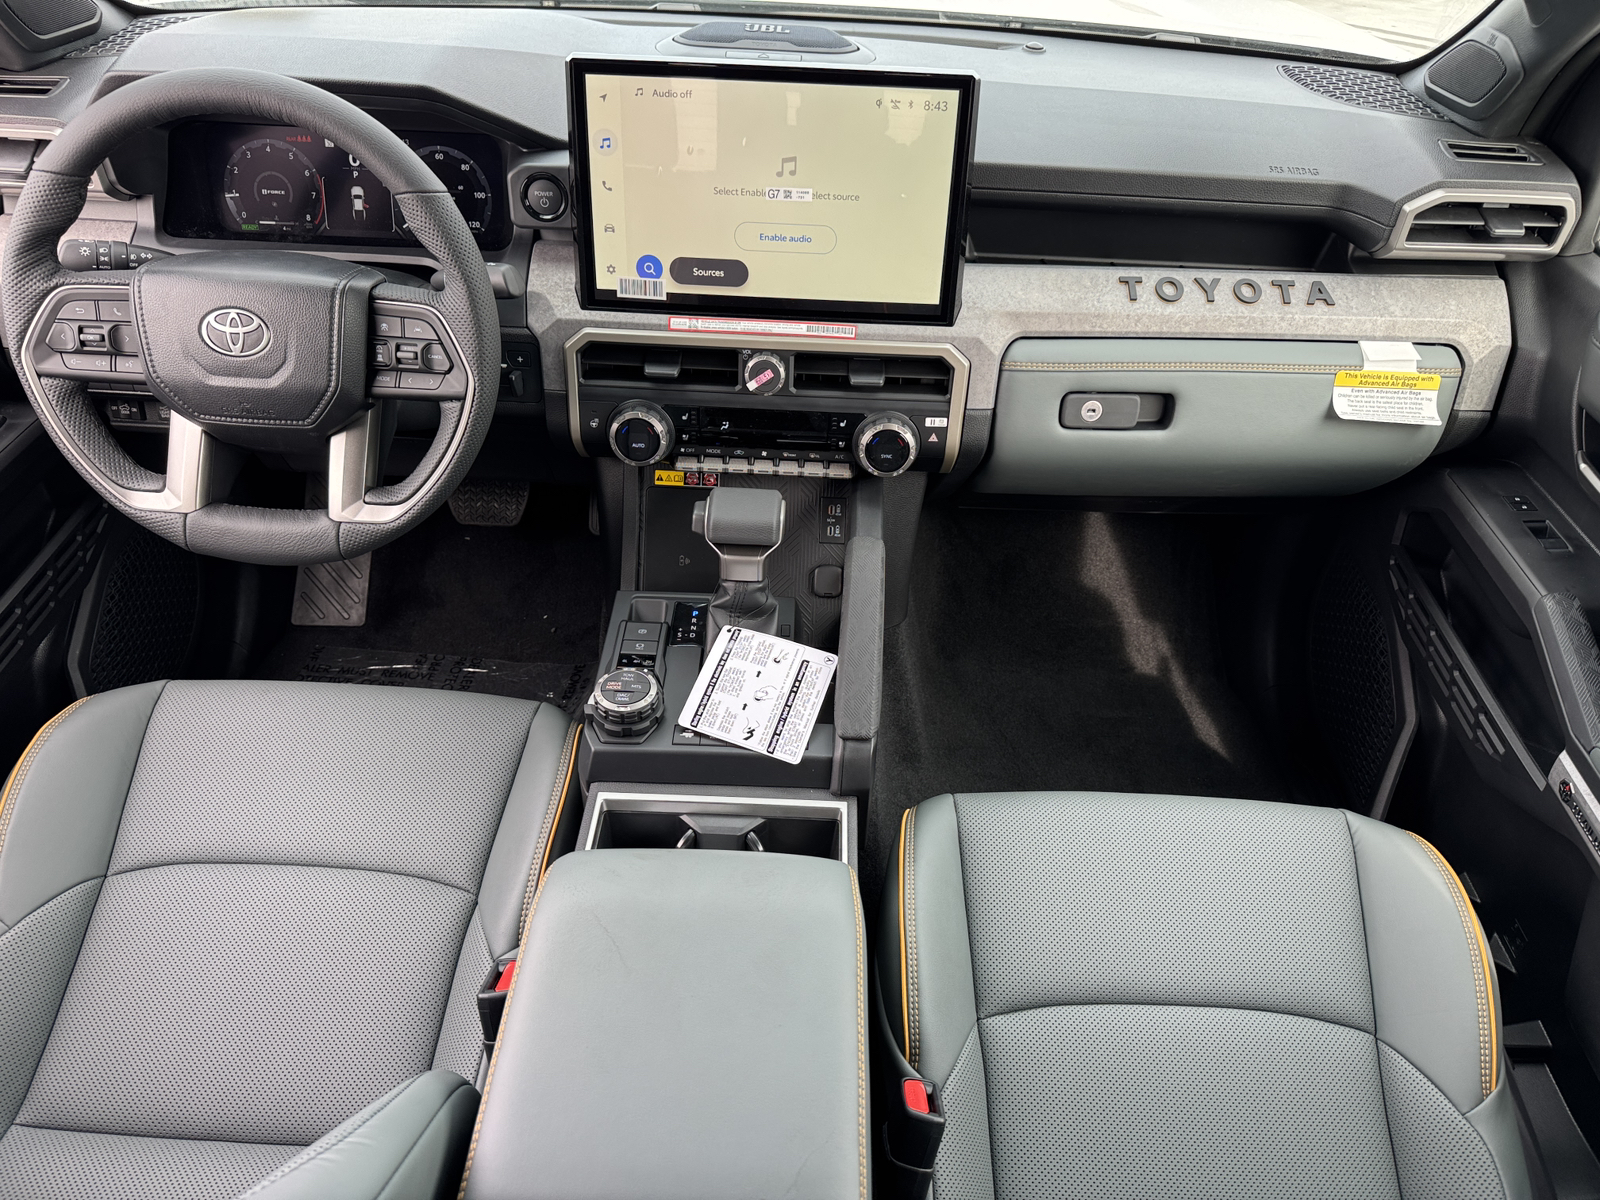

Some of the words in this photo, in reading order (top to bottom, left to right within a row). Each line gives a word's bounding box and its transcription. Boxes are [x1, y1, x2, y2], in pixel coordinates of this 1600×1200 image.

[744, 23, 790, 34] JBL
[652, 89, 678, 98] Audio
[680, 90, 692, 99] off
[924, 100, 948, 111] 8:43
[1287, 167, 1319, 176] AIRBAG
[714, 187, 738, 196] Select
[768, 189, 780, 199] G7
[812, 191, 830, 200] elect
[760, 233, 787, 242] Enable
[789, 235, 812, 243] audio
[693, 268, 724, 277] Sources
[1119, 276, 1335, 305] TOYOTA
[381, 669, 436, 681] REMOVE
